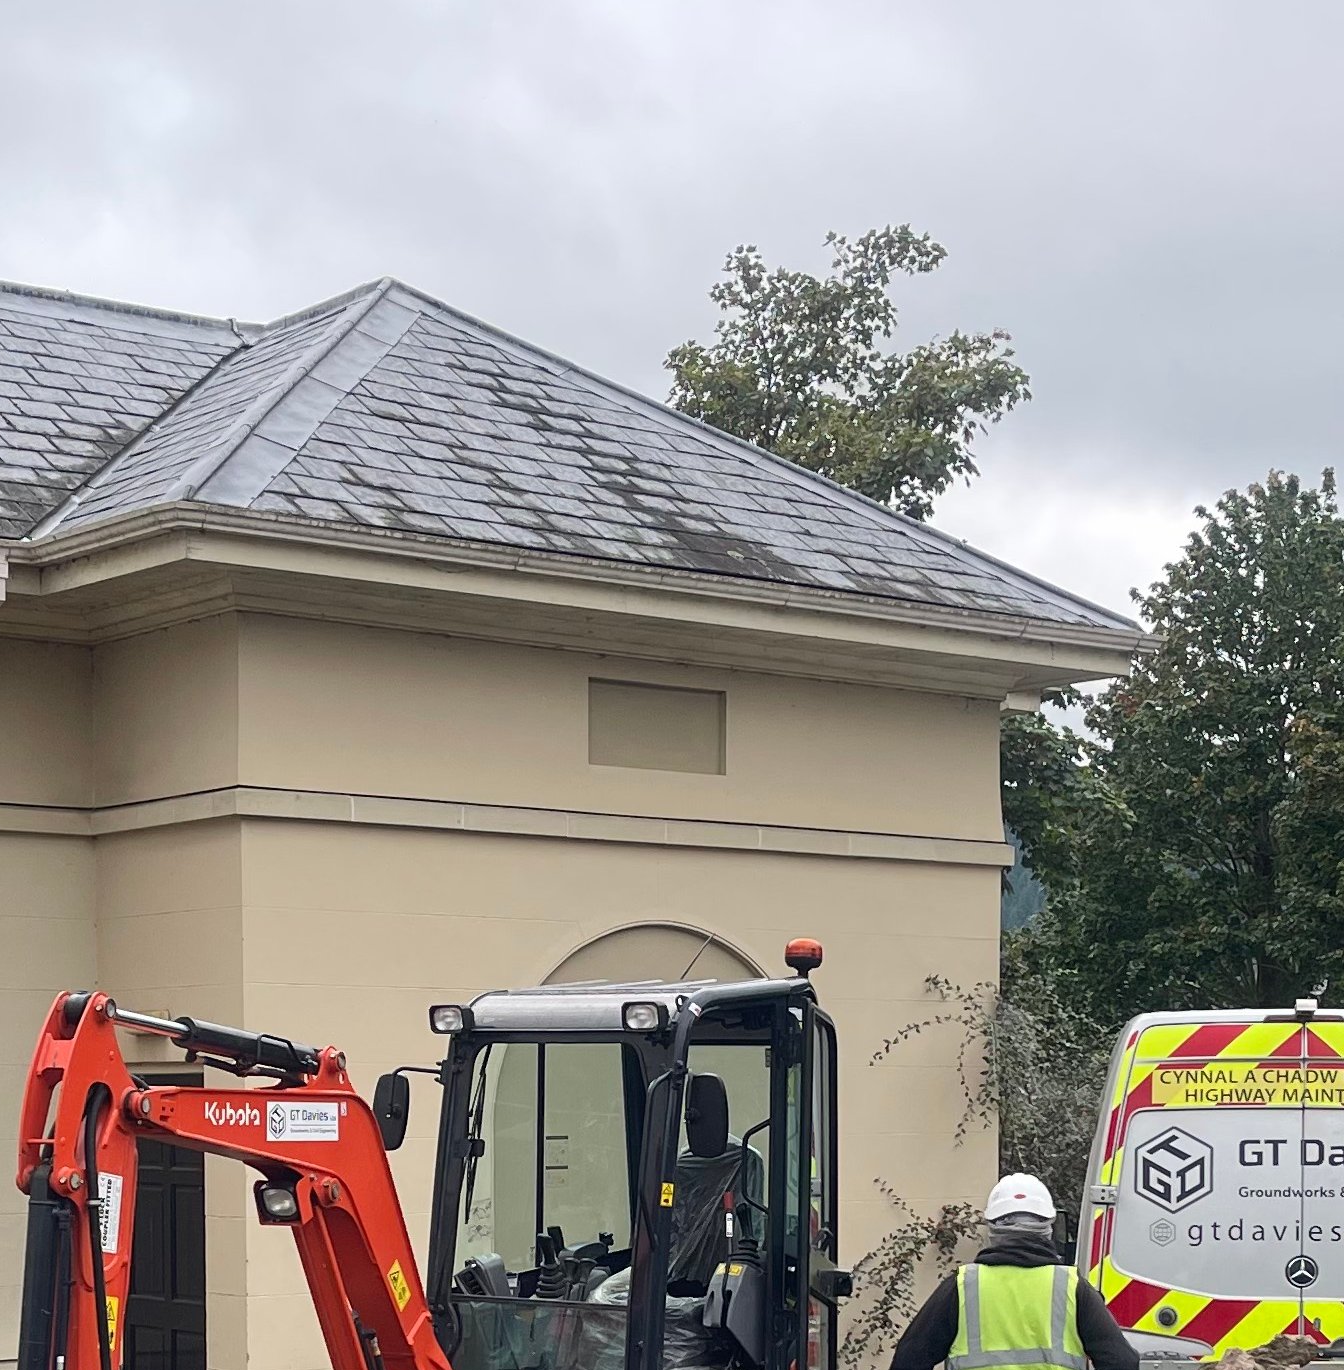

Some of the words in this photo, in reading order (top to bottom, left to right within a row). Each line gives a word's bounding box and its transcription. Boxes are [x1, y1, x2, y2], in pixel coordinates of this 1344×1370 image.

[1160, 1070, 1238, 1085] CYNNAL
[1244, 1070, 1257, 1084] A
[1263, 1070, 1340, 1084] CHADW
[1185, 1088, 1277, 1103] HIGHWAY
[204, 1101, 261, 1126] Kubota
[1238, 1139, 1287, 1167] GT
[1238, 1186, 1335, 1199] Groundworks
